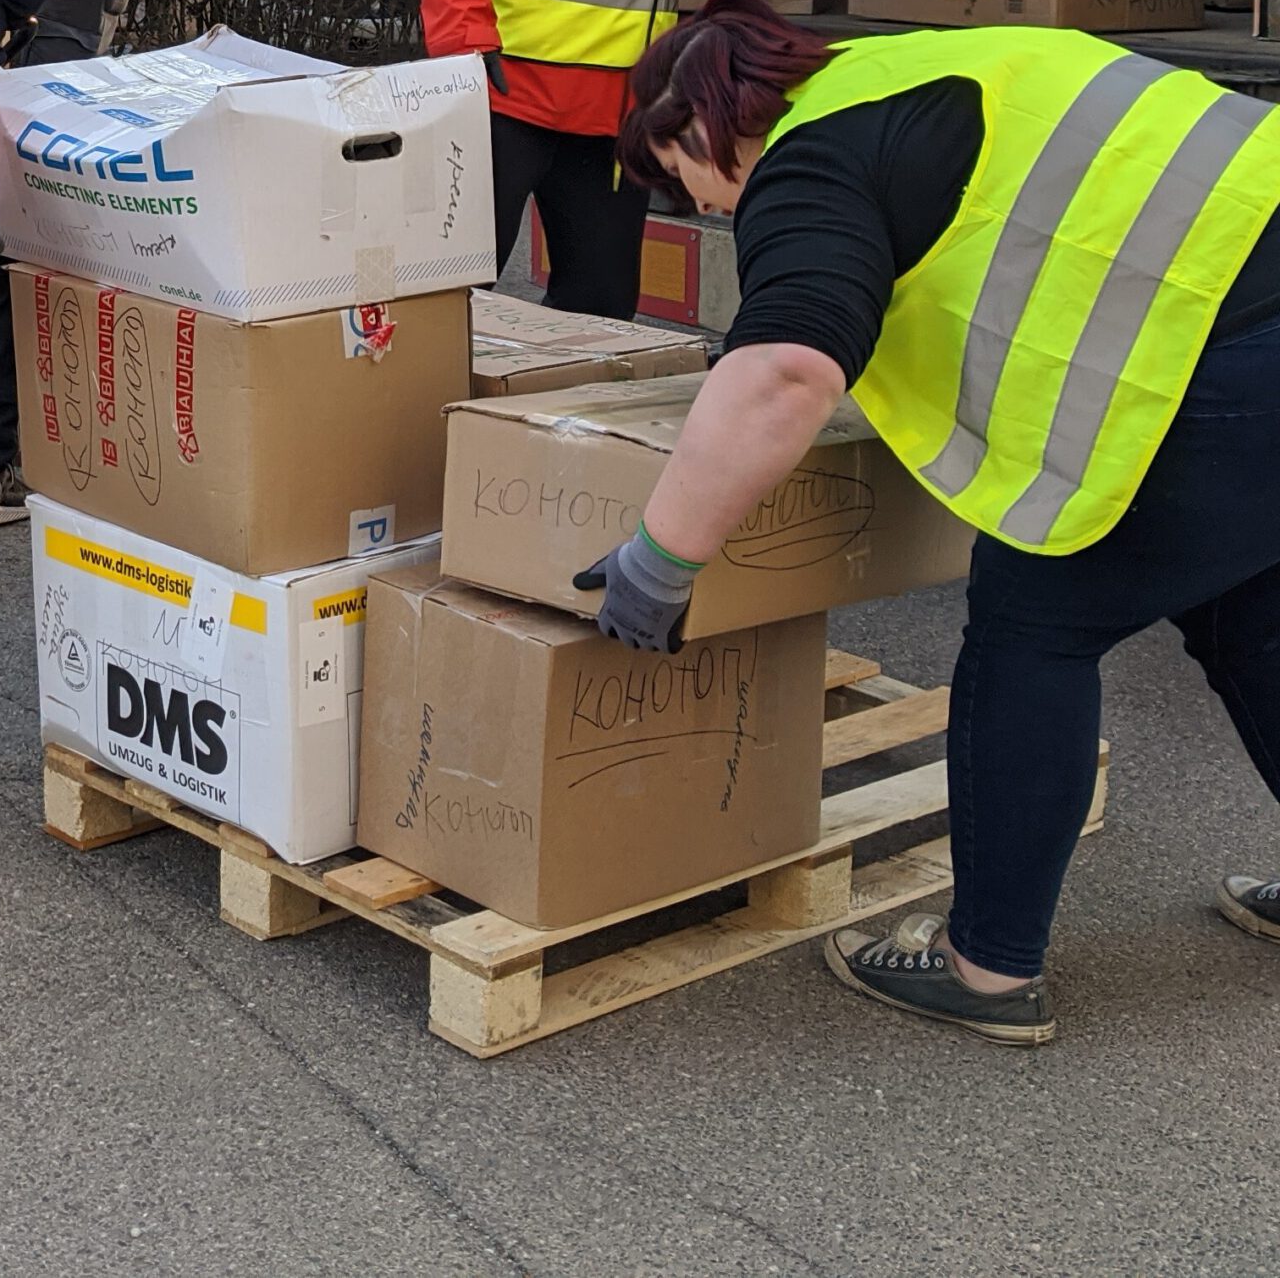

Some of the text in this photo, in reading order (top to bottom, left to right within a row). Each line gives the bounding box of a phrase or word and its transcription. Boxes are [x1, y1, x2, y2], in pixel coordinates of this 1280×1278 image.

[24, 172, 198, 215] CONNECTING ELEMENTS
[159, 282, 202, 302] conel.de
[474, 467, 643, 537] КОНОТО
[107, 662, 228, 775] DMS
[108, 741, 227, 805] UMZUG & LOGISTIK
